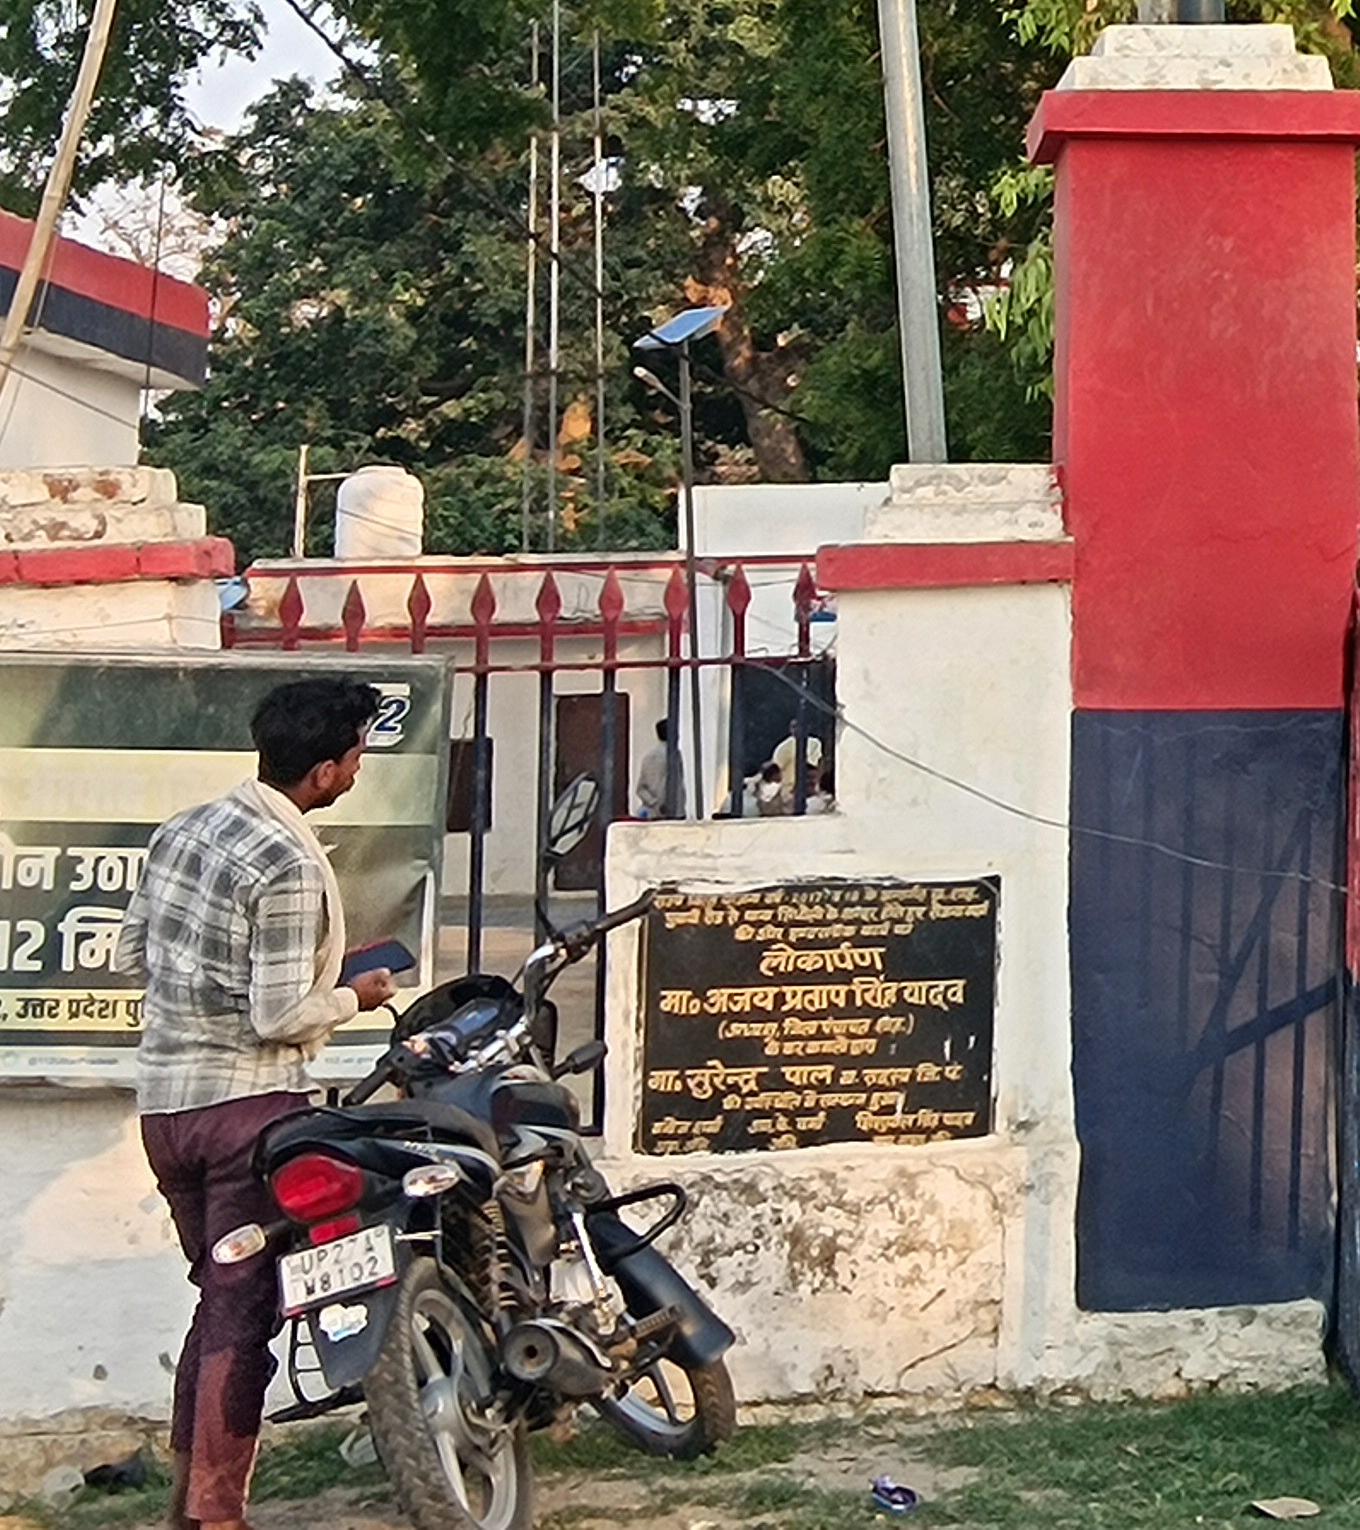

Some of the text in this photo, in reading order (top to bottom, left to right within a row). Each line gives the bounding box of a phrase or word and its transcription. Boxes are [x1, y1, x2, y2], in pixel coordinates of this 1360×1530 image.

[0, 833, 149, 891] ोन उठा
[0, 906, 128, 973] 12 मि
[759, 942, 887, 977] लोकार्पण
[15, 997, 61, 1020] उत्तर
[67, 992, 120, 1020] प्रदेश
[704, 986, 780, 1014] अजय
[780, 984, 851, 1013] प्रताप
[850, 973, 899, 1009] सिंह
[899, 979, 967, 1011] यादव
[685, 1060, 769, 1100] सुरेन्द्र
[780, 1064, 836, 1086] पाल
